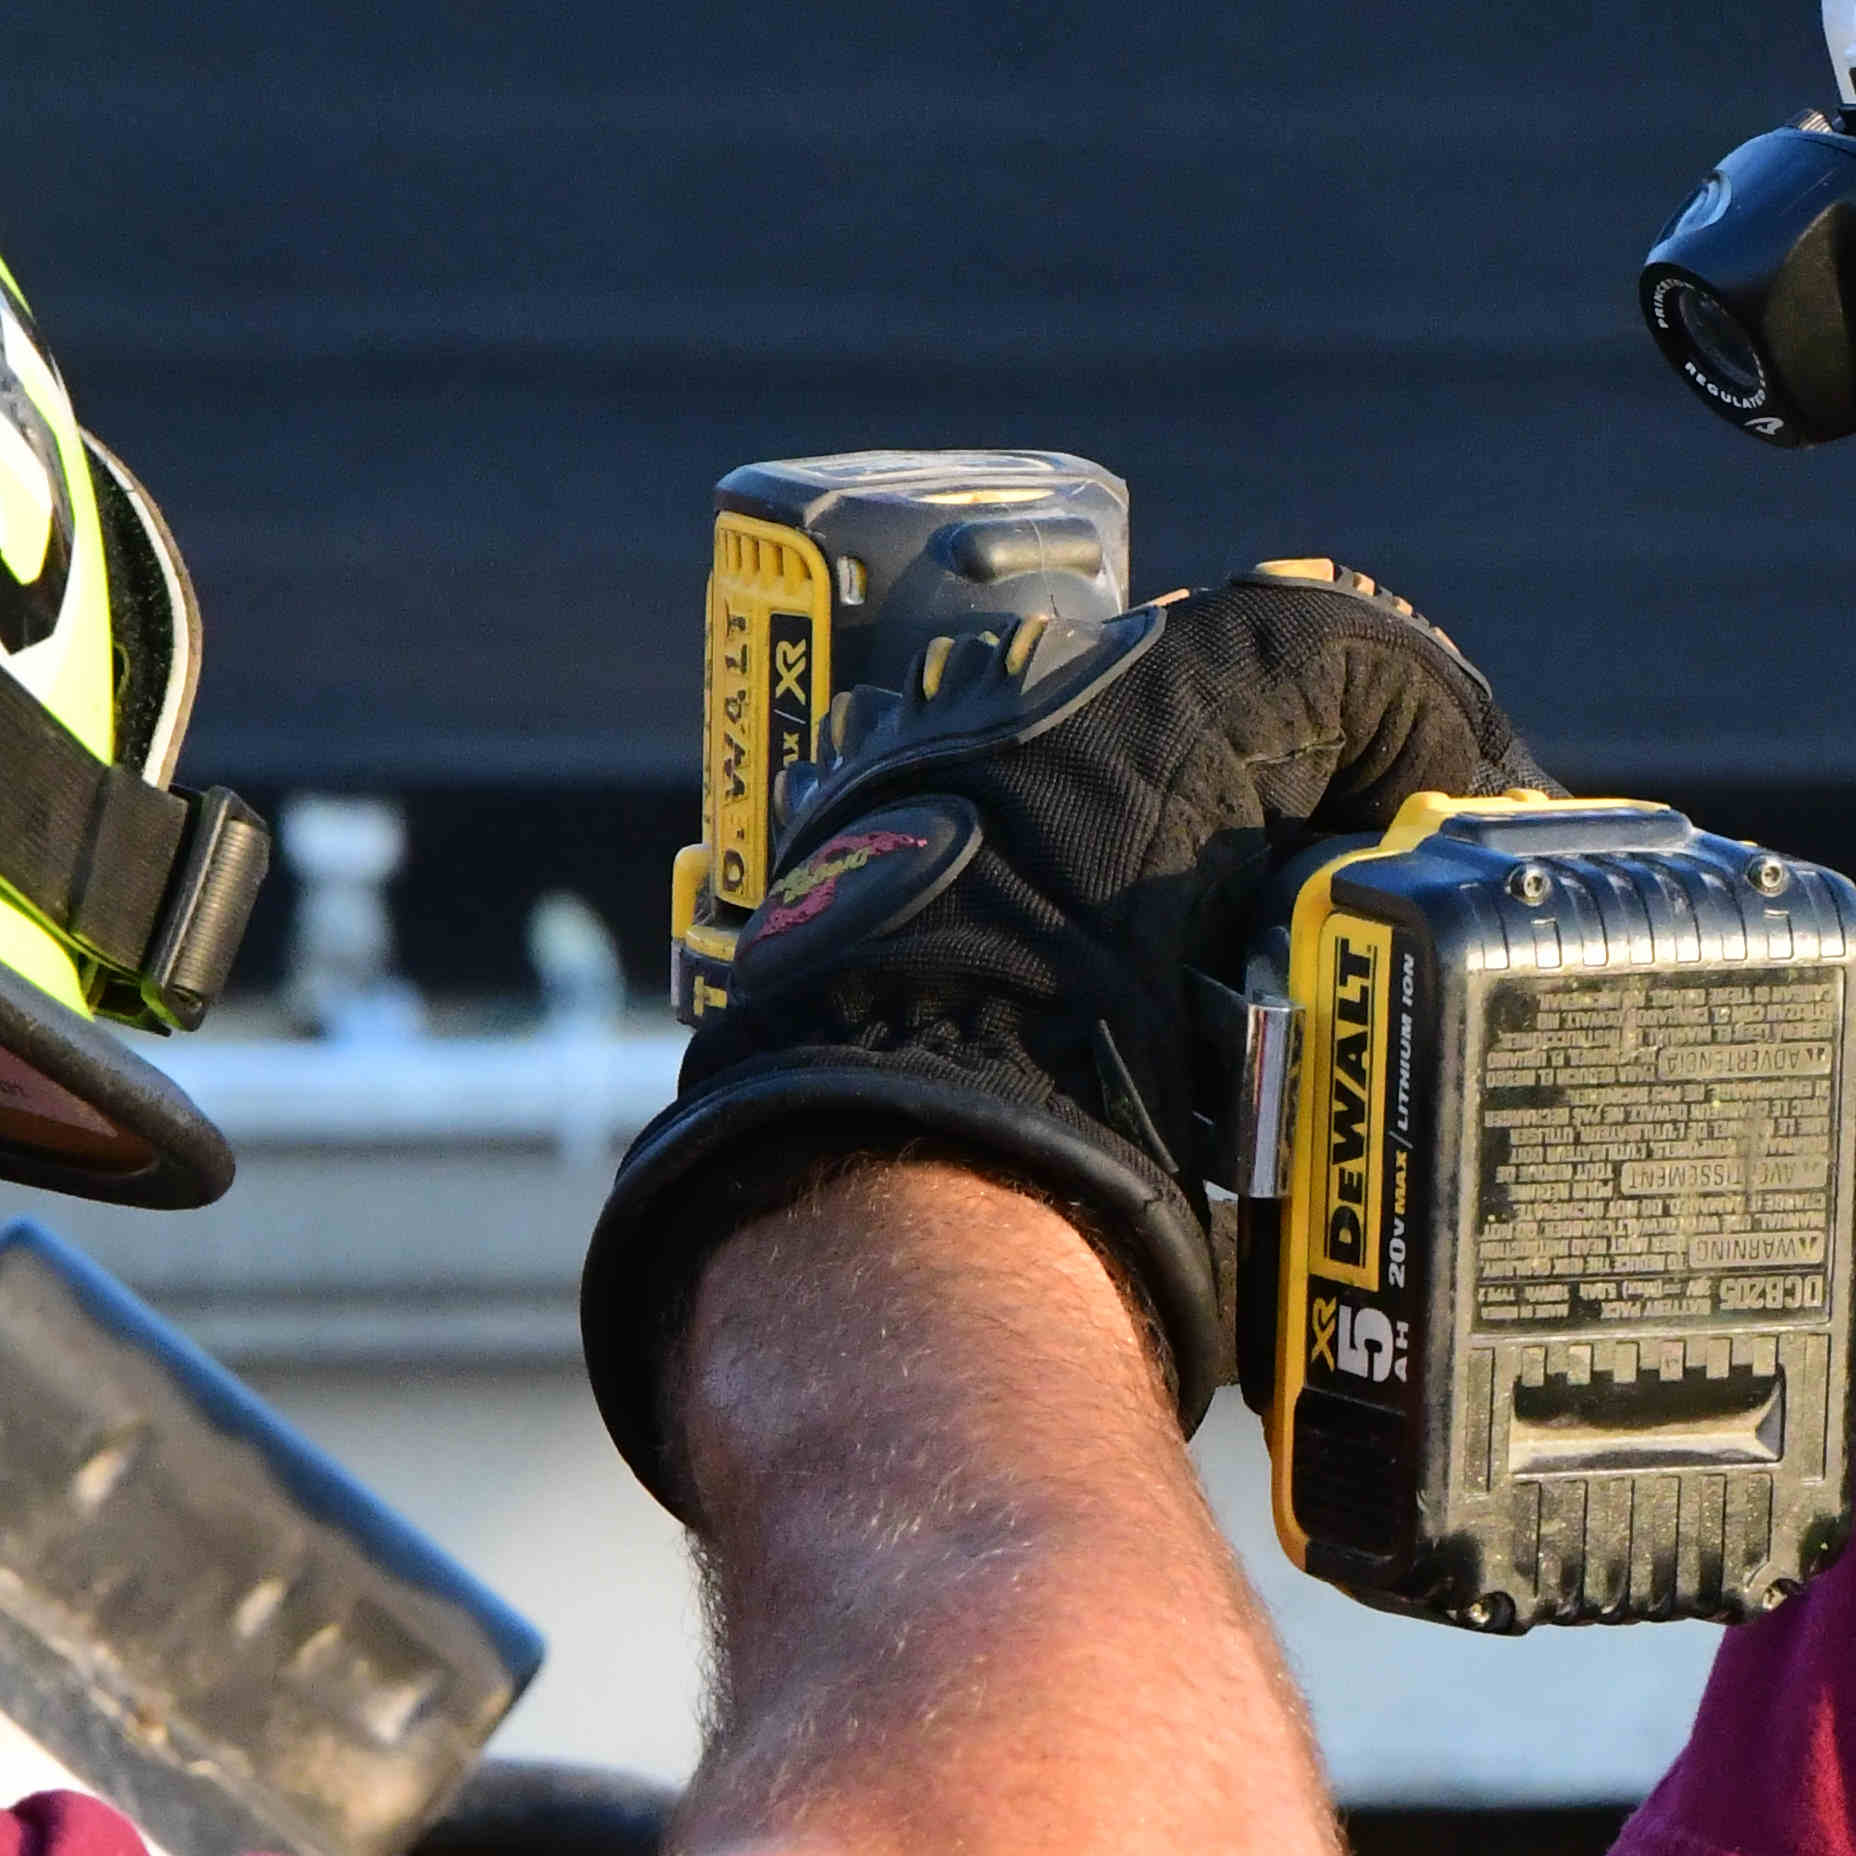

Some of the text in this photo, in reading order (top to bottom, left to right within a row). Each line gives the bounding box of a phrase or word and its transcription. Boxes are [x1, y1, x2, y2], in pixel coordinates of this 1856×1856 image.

[775, 639, 807, 706] XR
[1400, 952, 1416, 1007] ION
[1396, 1011, 1415, 1132] LITHIUM
[1694, 1236, 1795, 1261] WARNING
[1719, 1275, 1823, 1310] DCB205
[1310, 1297, 1337, 1372] XR
[1338, 1303, 1395, 1384] 5
[1393, 1320, 1410, 1384] AH
